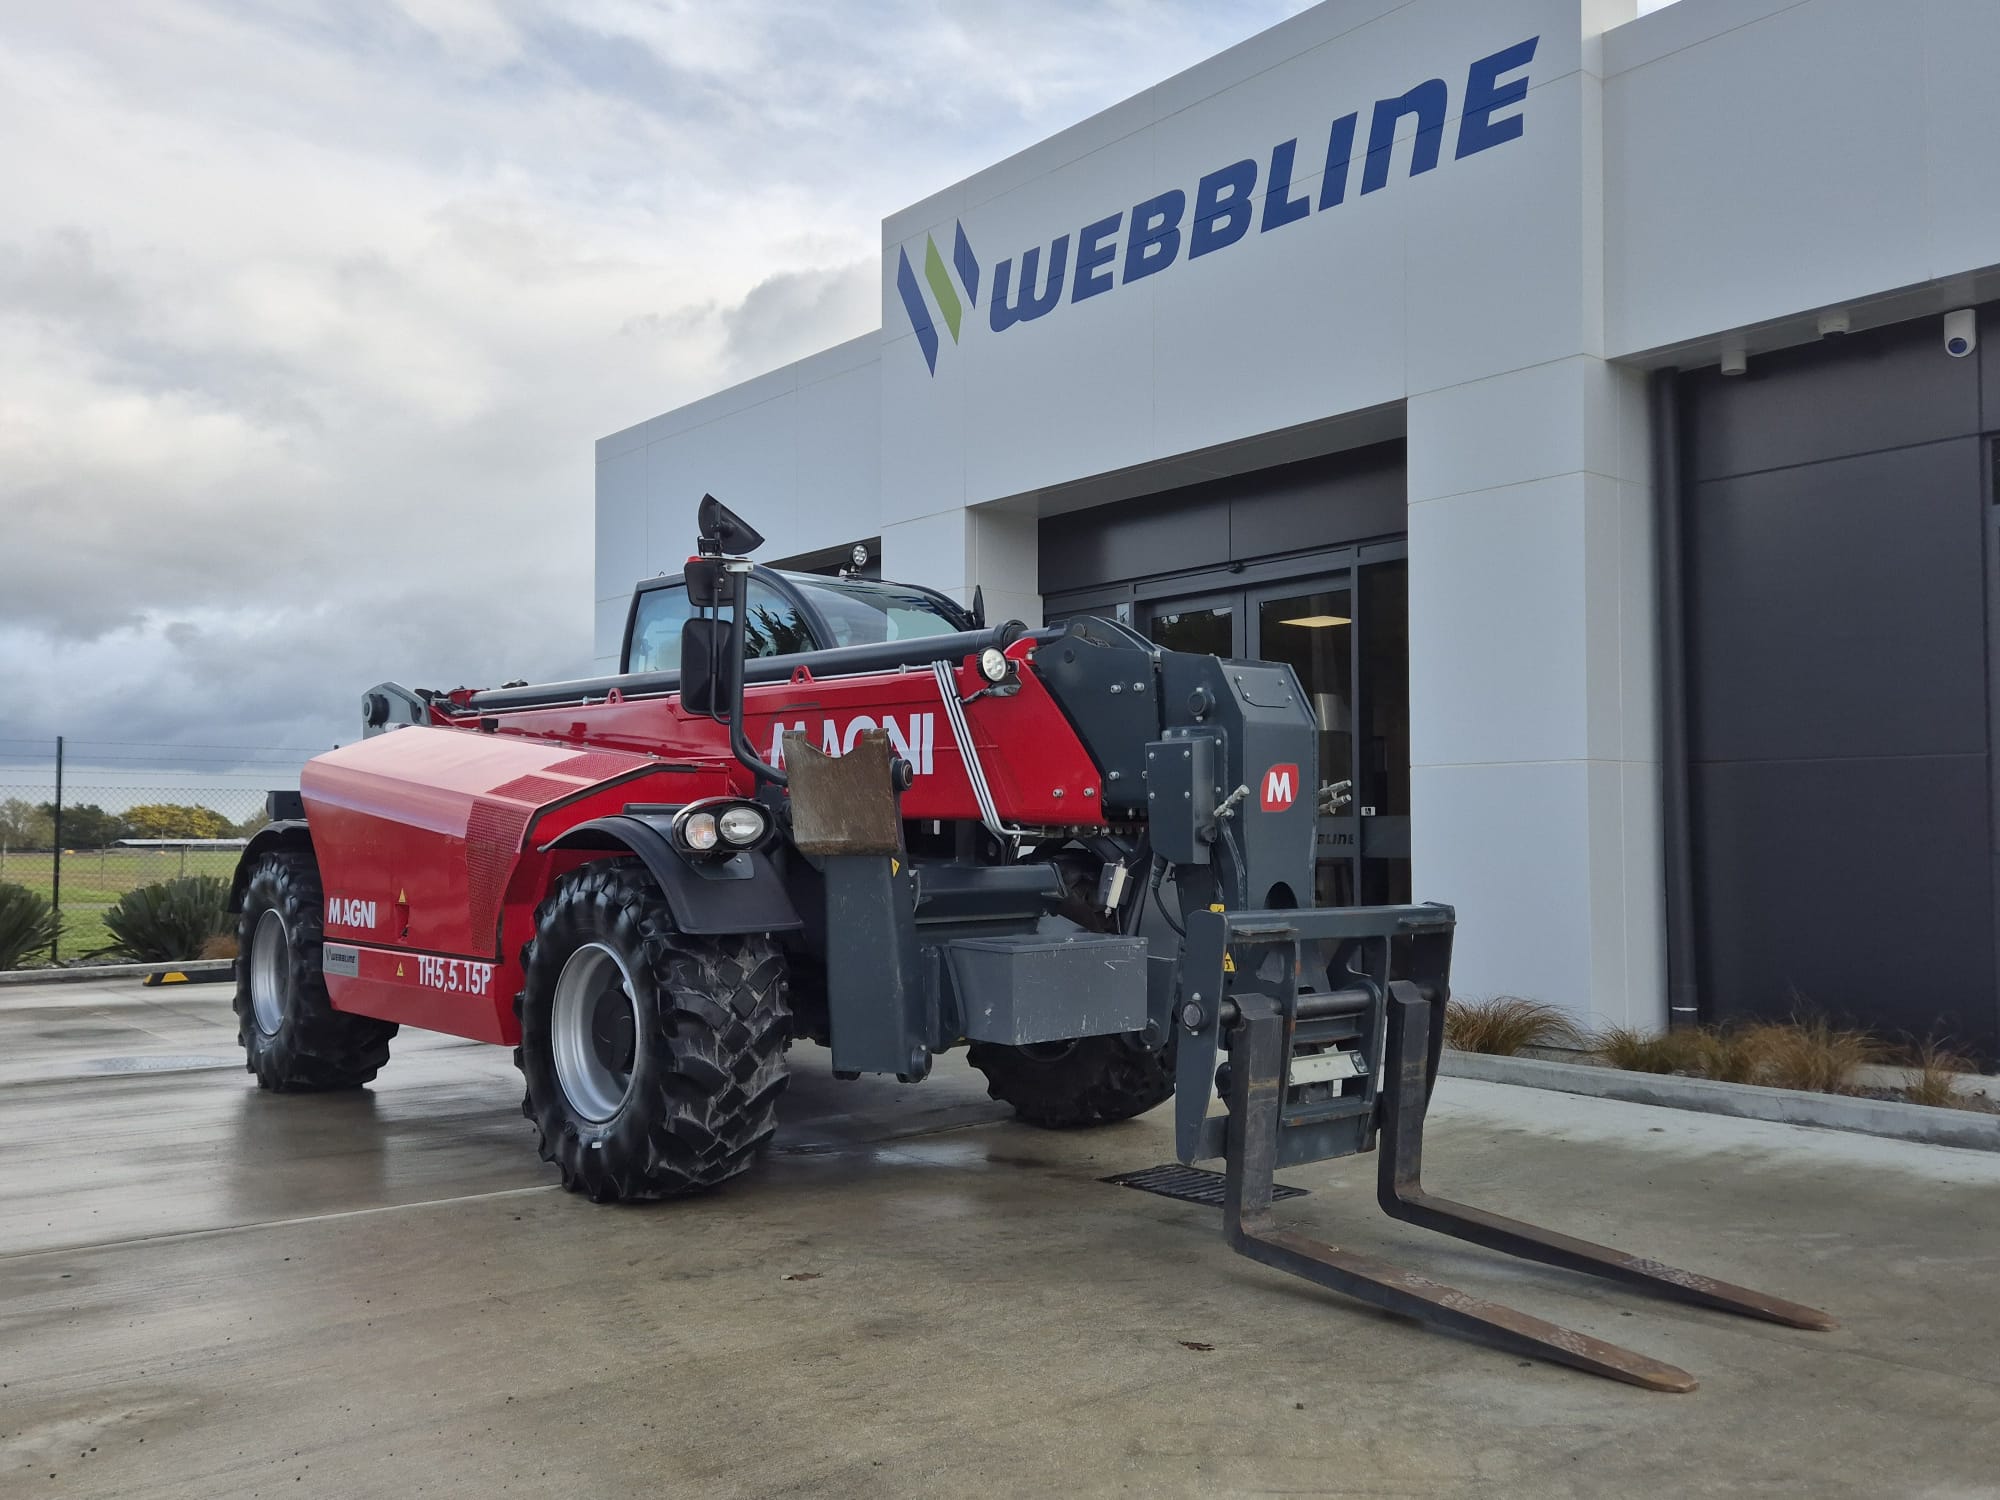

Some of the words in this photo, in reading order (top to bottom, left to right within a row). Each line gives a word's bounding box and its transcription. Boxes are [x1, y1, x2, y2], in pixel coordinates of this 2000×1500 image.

[989, 35, 1540, 333] WEBBLINE
[1266, 772, 1292, 803] M
[328, 897, 376, 929] MAGNI
[417, 955, 491, 995] TH5,5.15P
